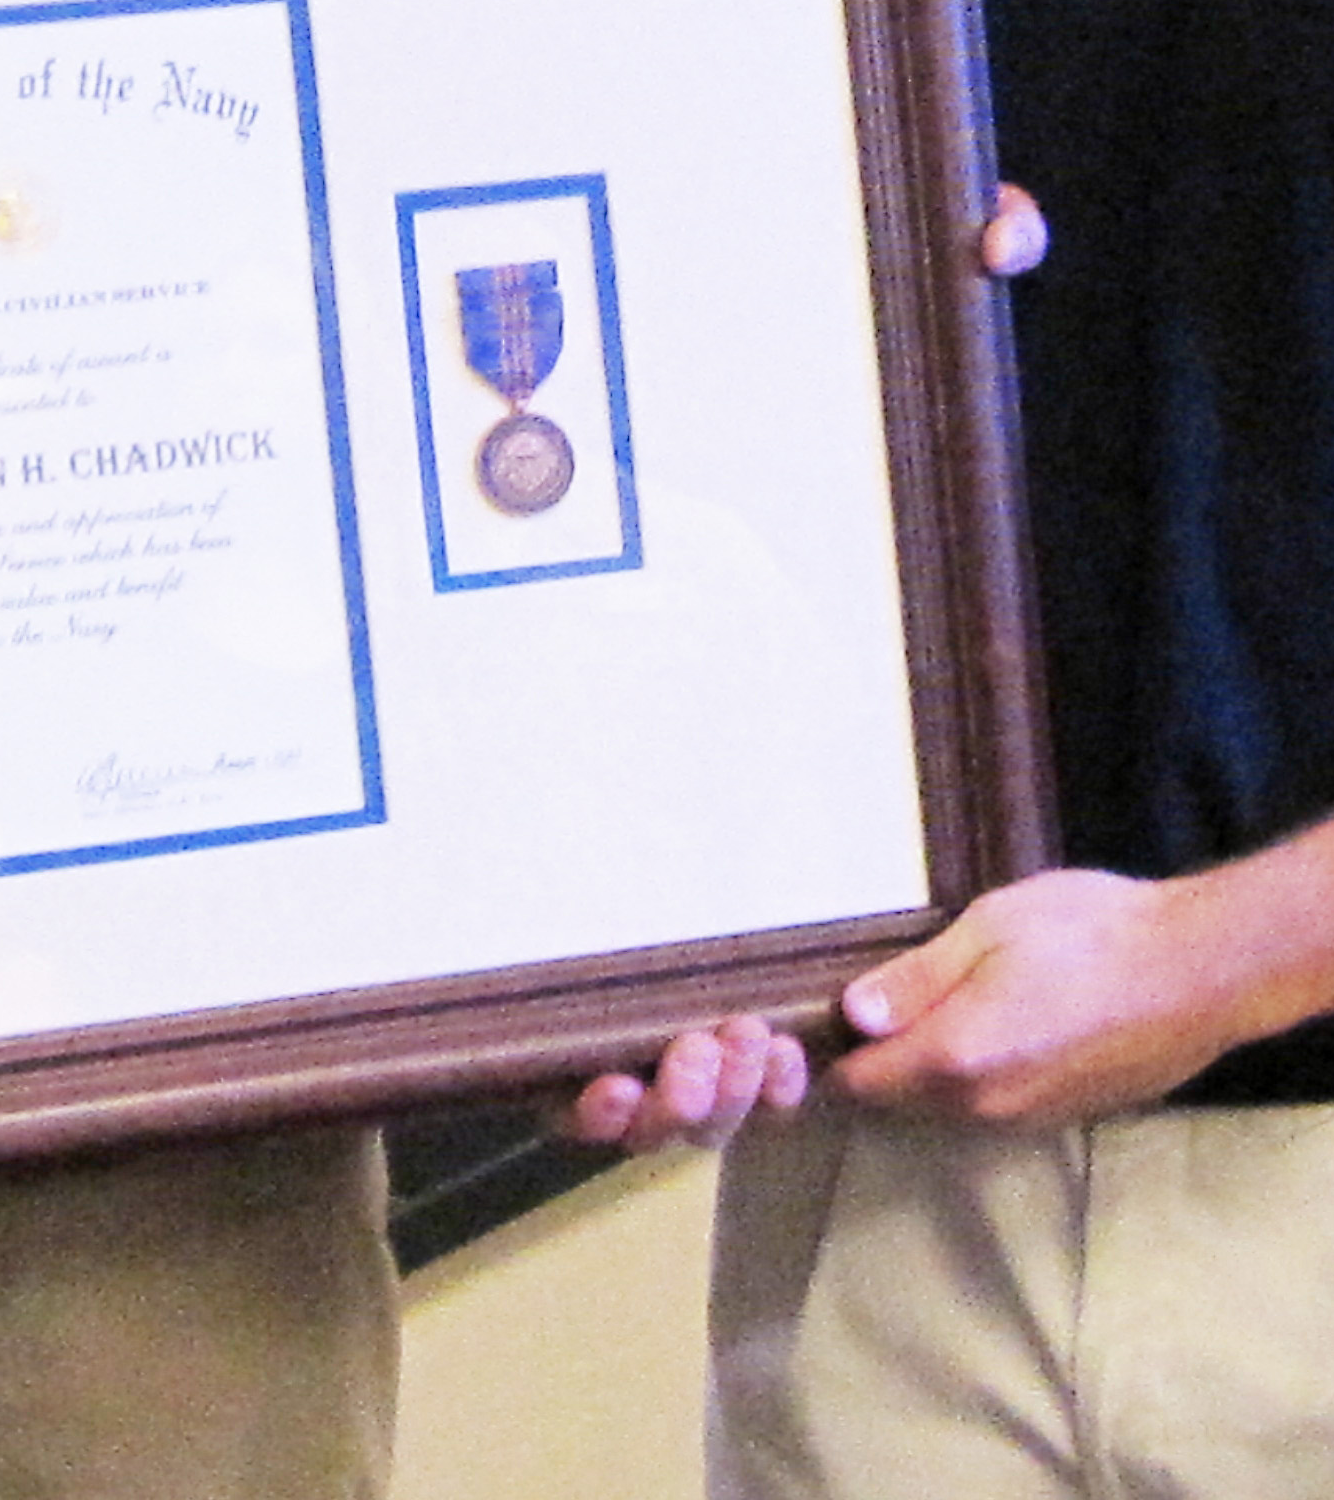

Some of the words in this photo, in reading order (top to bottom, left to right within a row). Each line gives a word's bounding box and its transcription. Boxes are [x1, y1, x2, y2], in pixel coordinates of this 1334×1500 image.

[17, 57, 57, 100] of
[77, 58, 135, 116] the
[153, 60, 260, 145] Navy
[49, 347, 76, 384] of
[21, 453, 58, 485] H.
[69, 429, 277, 480] CHADWICK
[11, 509, 58, 535] and
[200, 487, 228, 523] of
[141, 532, 183, 558] has
[63, 580, 110, 603] and
[10, 619, 44, 646] the
